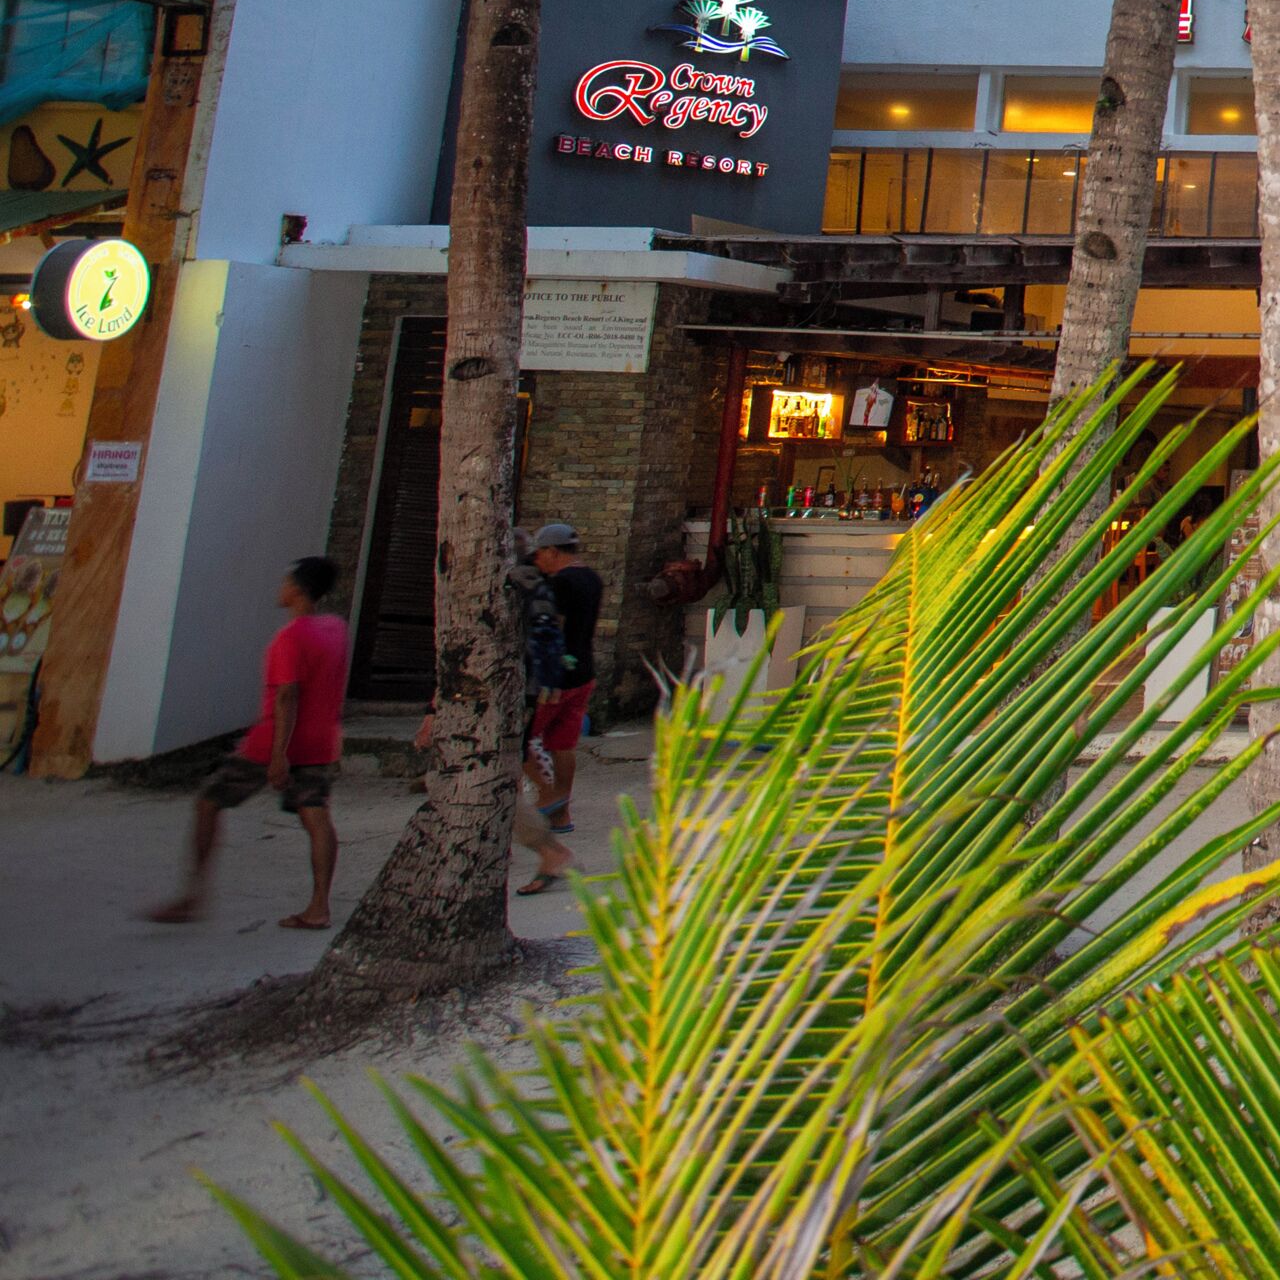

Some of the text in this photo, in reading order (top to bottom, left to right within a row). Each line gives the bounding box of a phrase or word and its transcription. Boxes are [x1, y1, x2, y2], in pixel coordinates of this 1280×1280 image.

[670, 62, 756, 98] Crown
[575, 59, 769, 139] Regency
[558, 135, 770, 177] BEACH RESORT
[524, 292, 626, 303] OTICE TO THE PUBLIC
[75, 303, 133, 333] Ice Land
